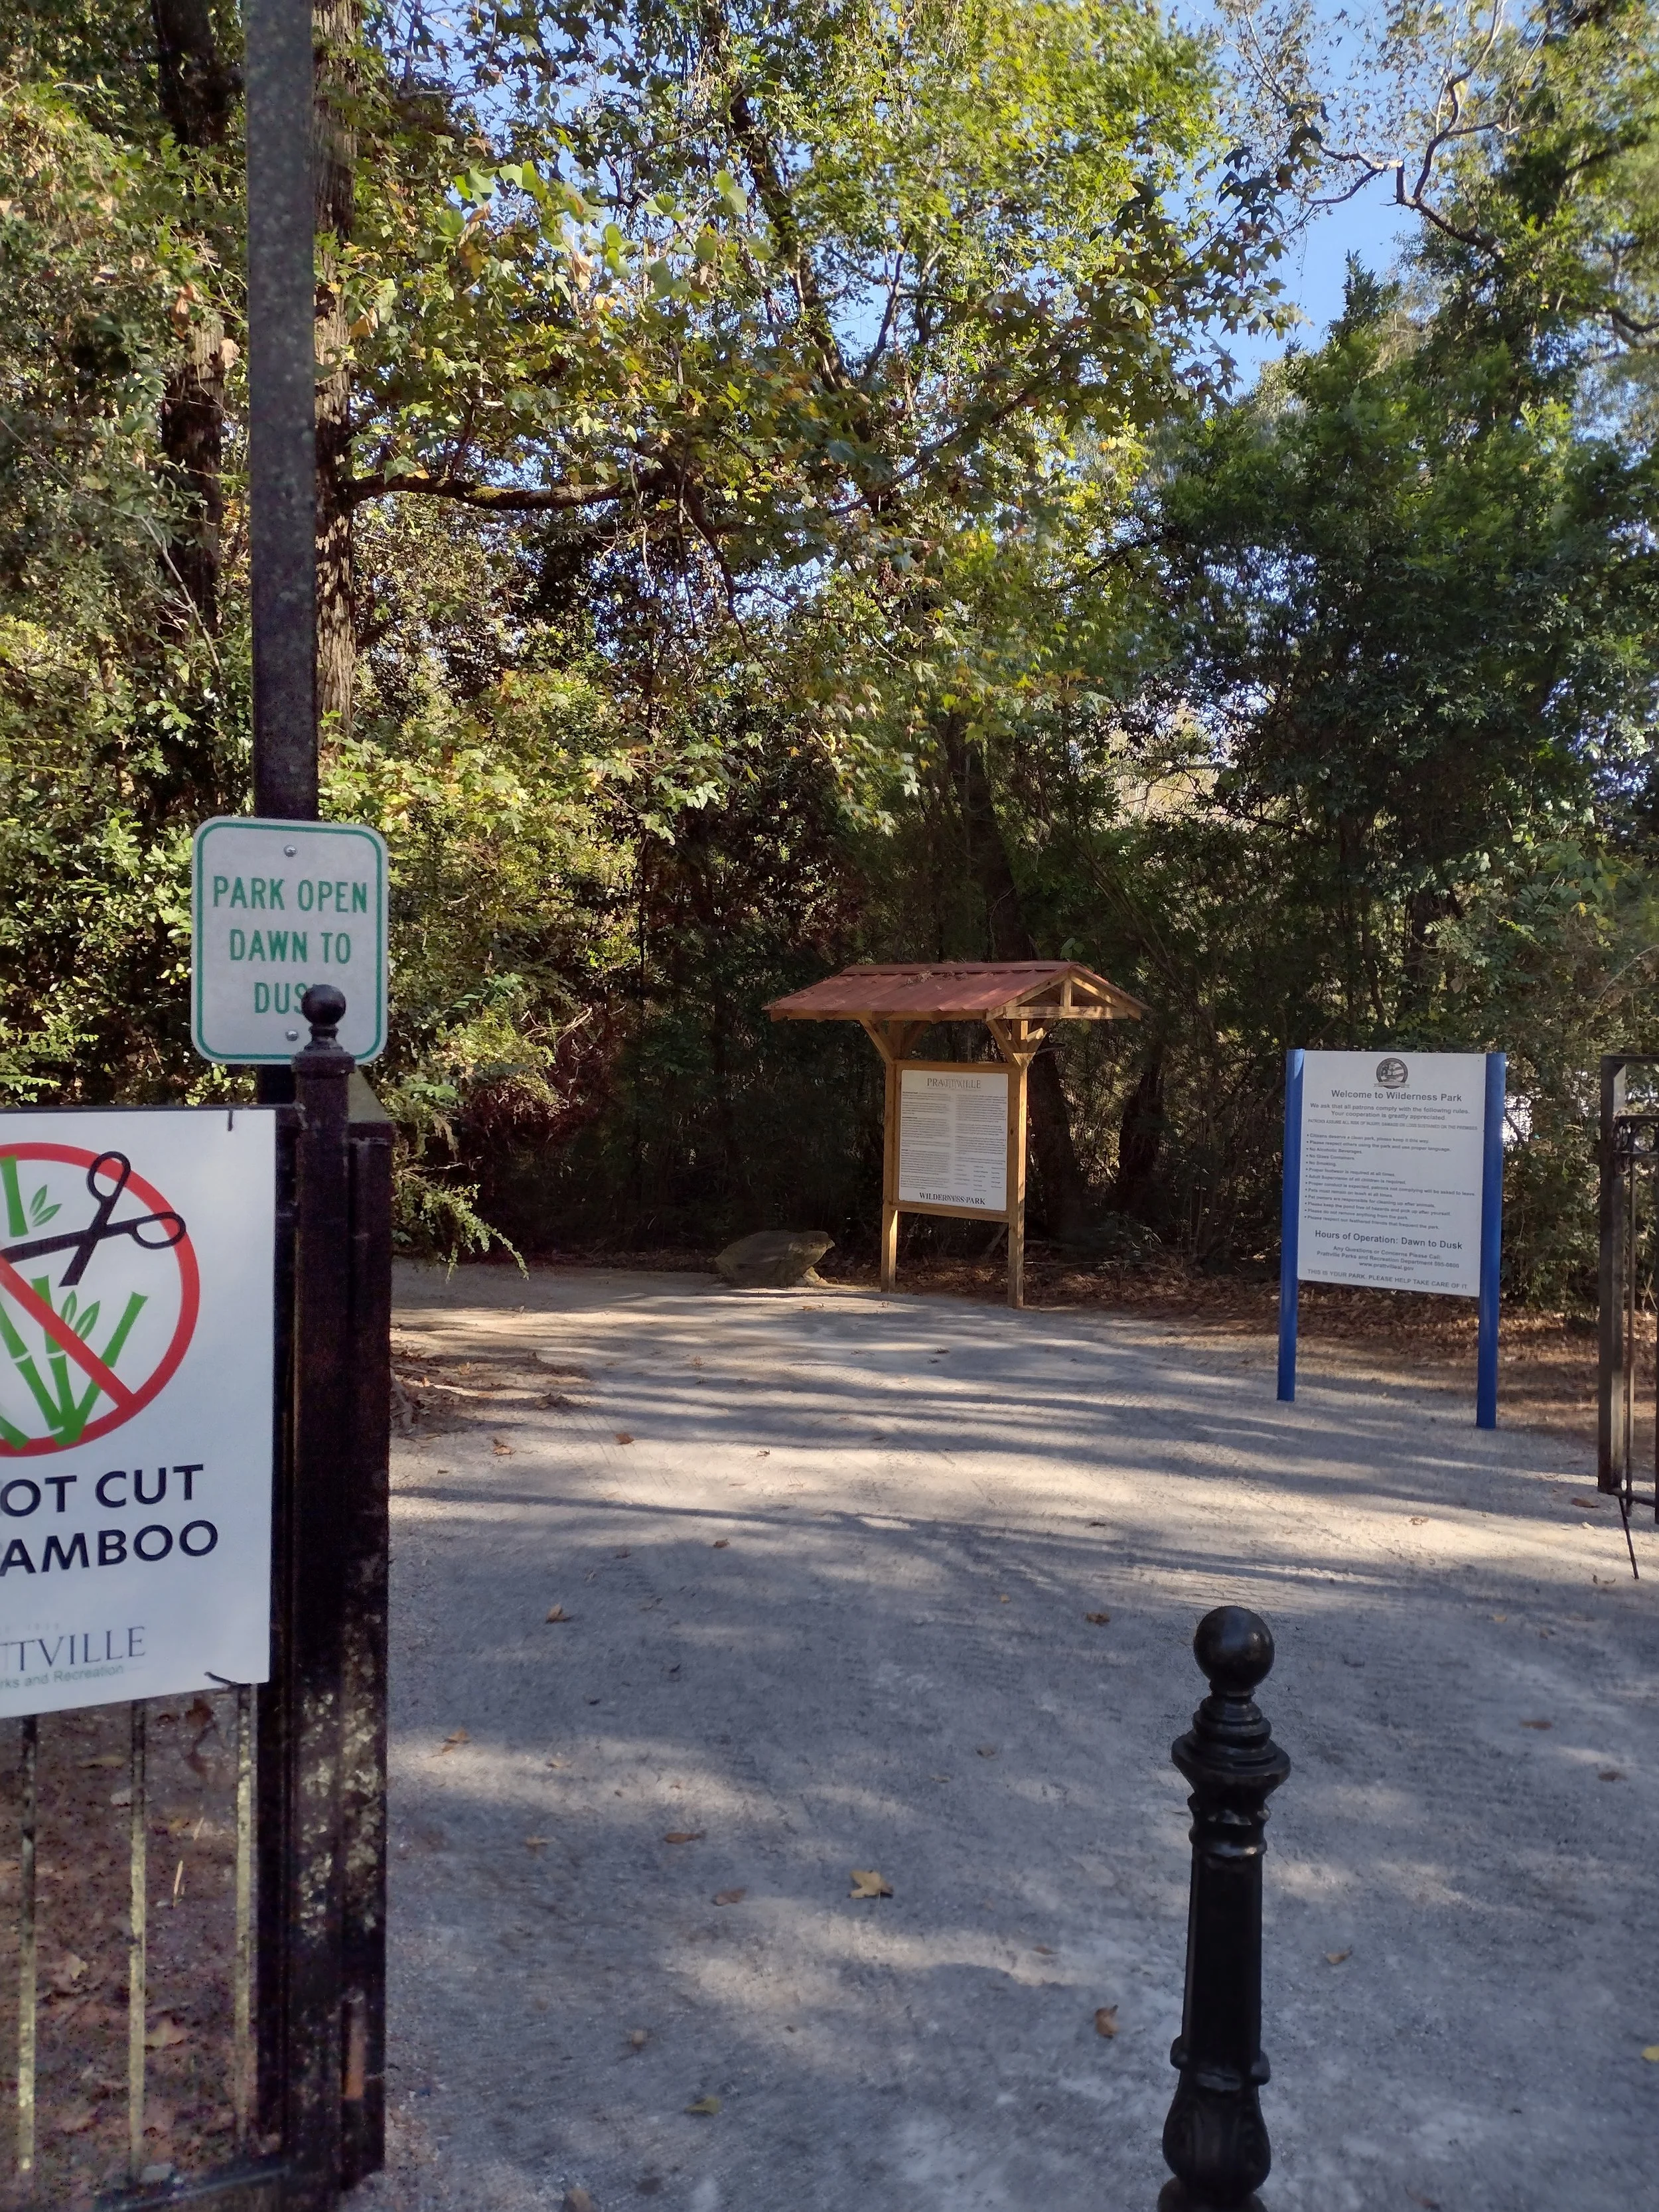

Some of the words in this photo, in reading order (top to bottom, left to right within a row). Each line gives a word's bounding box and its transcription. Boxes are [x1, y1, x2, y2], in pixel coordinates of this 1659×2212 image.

[213, 876, 285, 910] PARK
[297, 879, 367, 913] OPEN
[230, 929, 308, 962] DAWN
[321, 932, 350, 964] TO
[254, 982, 308, 1014] DUS
[1331, 1089, 1372, 1098] Welcome
[1374, 1090, 1384, 1099] to
[1386, 1090, 1437, 1101] Wilderness
[1440, 1092, 1462, 1102] Park
[919, 1192, 965, 1203] WILDERNESS
[1315, 1229, 1340, 1239] Hours
[1342, 1232, 1351, 1240] of
[1352, 1232, 1398, 1246] Operation:
[1401, 1236, 1425, 1246] Dawn
[1427, 1238, 1437, 1247] to
[1439, 1239, 1463, 1250] Dusk
[0, 1475, 77, 1517] OT
[95, 1464, 203, 1508] CUT
[0, 1520, 218, 1577] AMBOO
[25, 1673, 48, 1686] and
[54, 1666, 123, 1682] Recreation
